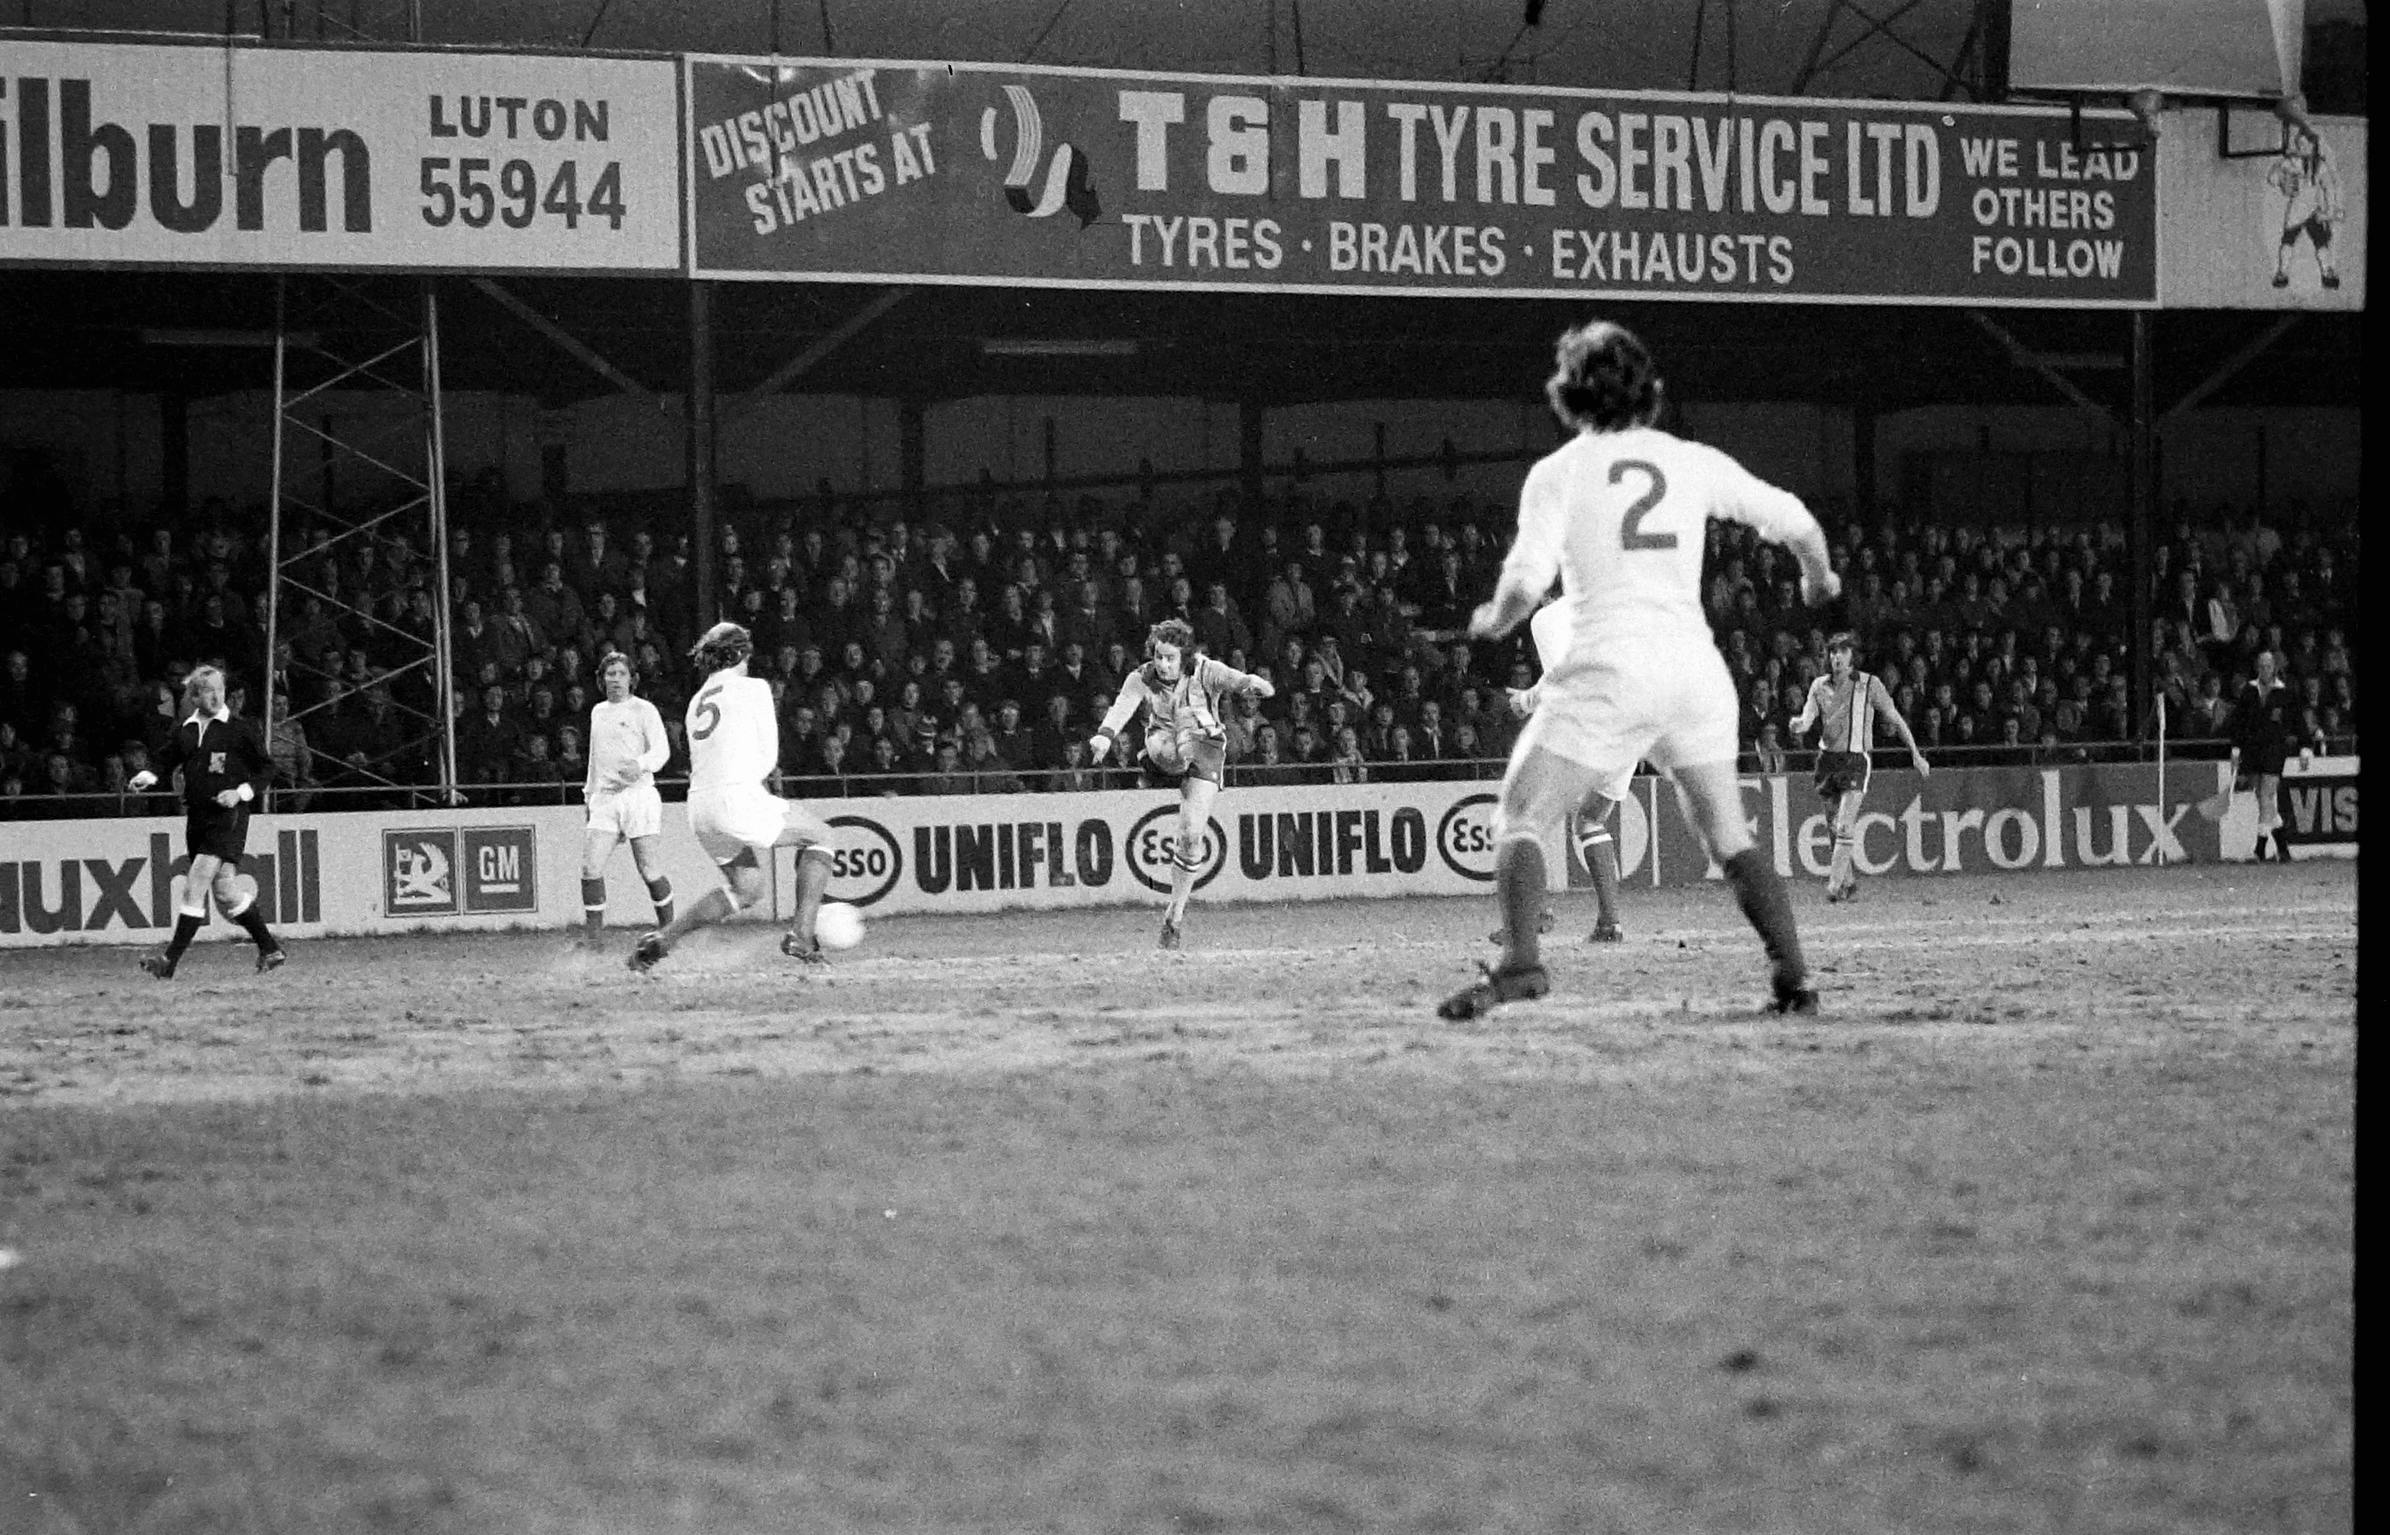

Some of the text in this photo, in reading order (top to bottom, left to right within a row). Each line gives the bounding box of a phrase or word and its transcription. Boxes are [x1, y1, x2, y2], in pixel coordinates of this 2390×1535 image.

[0, 76, 372, 234] lburn
[429, 95, 609, 142] LUTON
[699, 68, 882, 179] DISCOUNT
[1118, 90, 1941, 218] T & H TYRE SERVICE LTD
[418, 157, 626, 230] 55944
[745, 121, 937, 236] STARTS AT
[1959, 137, 2139, 182] WE LEAD
[1972, 188, 2116, 230] OTHERS
[1122, 212, 1796, 285] TYRES BRAKES EXHAUSTS
[1972, 236, 2124, 280] FOLLOW
[1608, 459, 1678, 550] 2
[692, 684, 724, 741] 5
[913, 819, 1114, 894] UNIFLO
[1238, 805, 1427, 881] UNIFLO
[1705, 768, 2190, 880] lectrolux
[479, 845, 520, 882] GM
